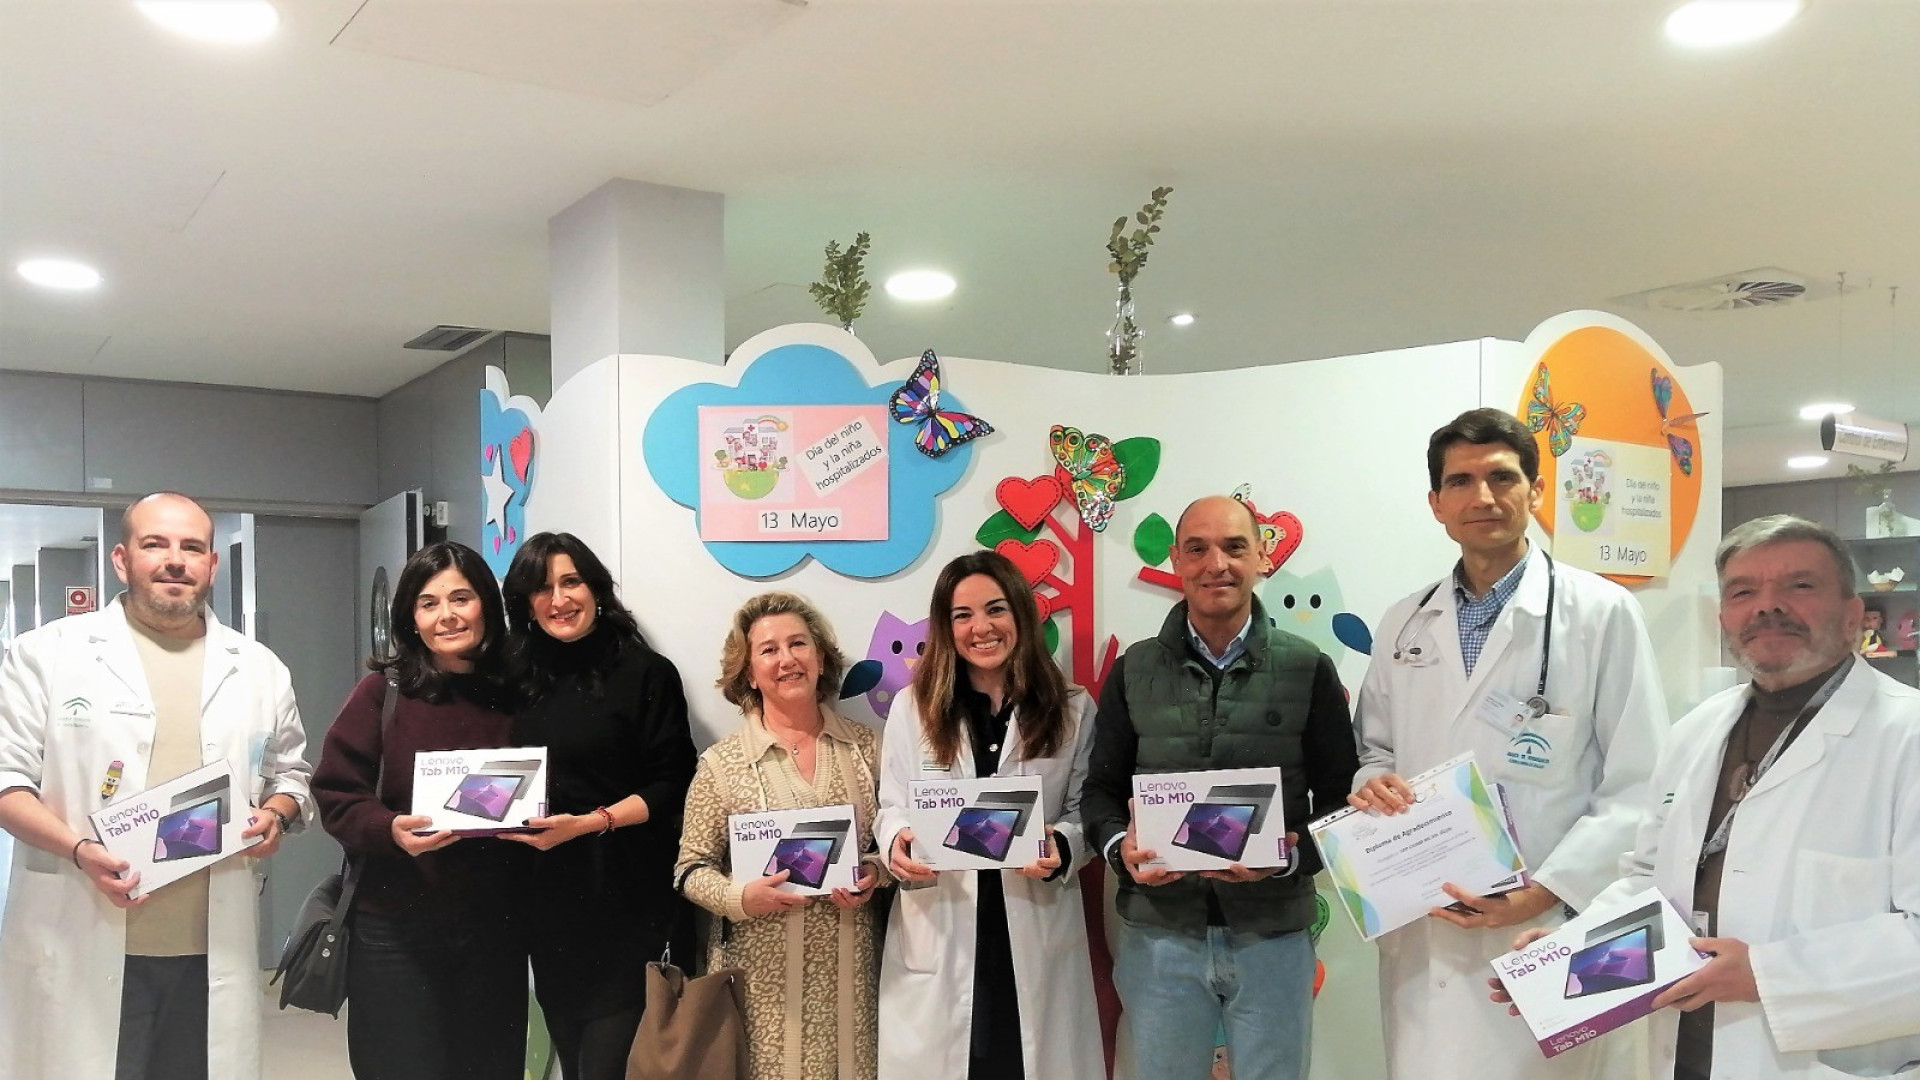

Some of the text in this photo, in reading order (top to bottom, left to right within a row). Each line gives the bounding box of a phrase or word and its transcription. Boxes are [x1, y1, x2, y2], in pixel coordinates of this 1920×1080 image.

[824, 433, 840, 449] del
[840, 421, 863, 439] niño
[822, 439, 863, 472] y la niña
[815, 445, 882, 491] hospitalizados
[761, 512, 839, 532] 13 Mayo
[1600, 545, 1647, 566] 13 Mayo
[420, 756, 464, 766] Lenovo
[420, 766, 442, 776] Tab
[914, 786, 959, 798] Lenovo
[1139, 780, 1187, 793] Lenovo
[914, 797, 965, 810] Tab M10
[1139, 791, 1195, 805] Tab M10
[100, 802, 148, 828] Lenovo
[105, 808, 160, 839] Tab M10
[733, 819, 776, 831] Lenovo
[735, 828, 782, 842] Tab M10
[1501, 941, 1557, 970] Lenovo
[1507, 946, 1572, 980] Tab M10
[1549, 1025, 1589, 1046] Lenovo
[1553, 1028, 1597, 1053] Tab M10
